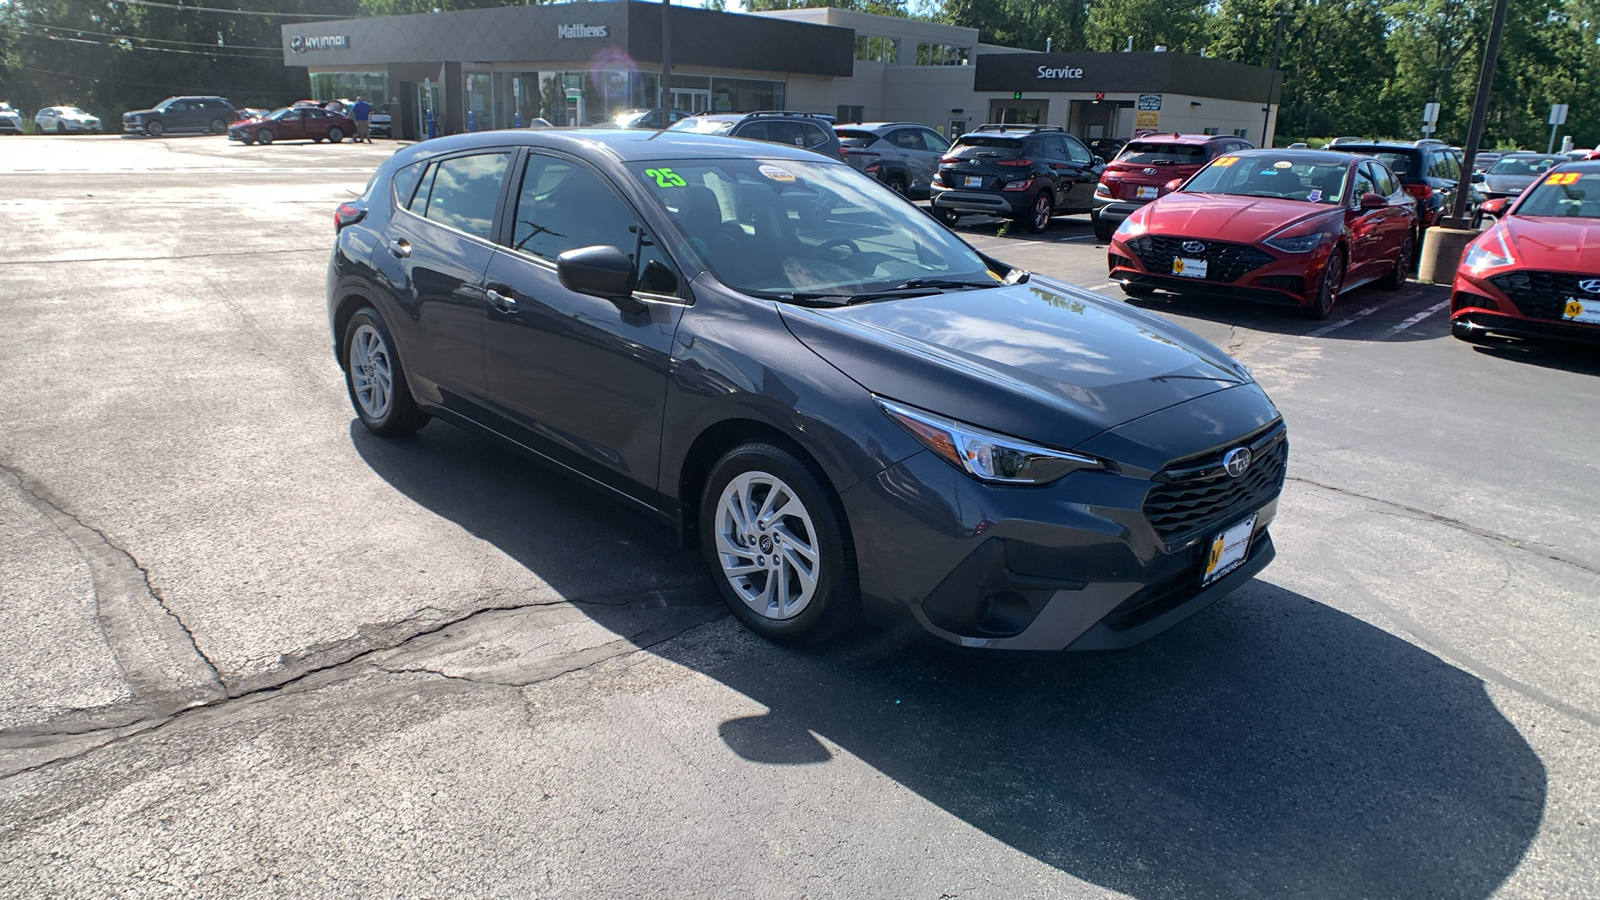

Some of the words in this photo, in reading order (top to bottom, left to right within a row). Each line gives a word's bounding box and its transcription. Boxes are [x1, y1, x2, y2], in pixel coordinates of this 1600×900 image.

[557, 23, 609, 39] Matthews
[304, 35, 347, 49] HYUNDAI
[1036, 65, 1084, 79] Service
[644, 168, 687, 188] 25
[1544, 172, 1580, 185] 23
[1175, 262, 1184, 270] M
[1567, 304, 1581, 315] M
